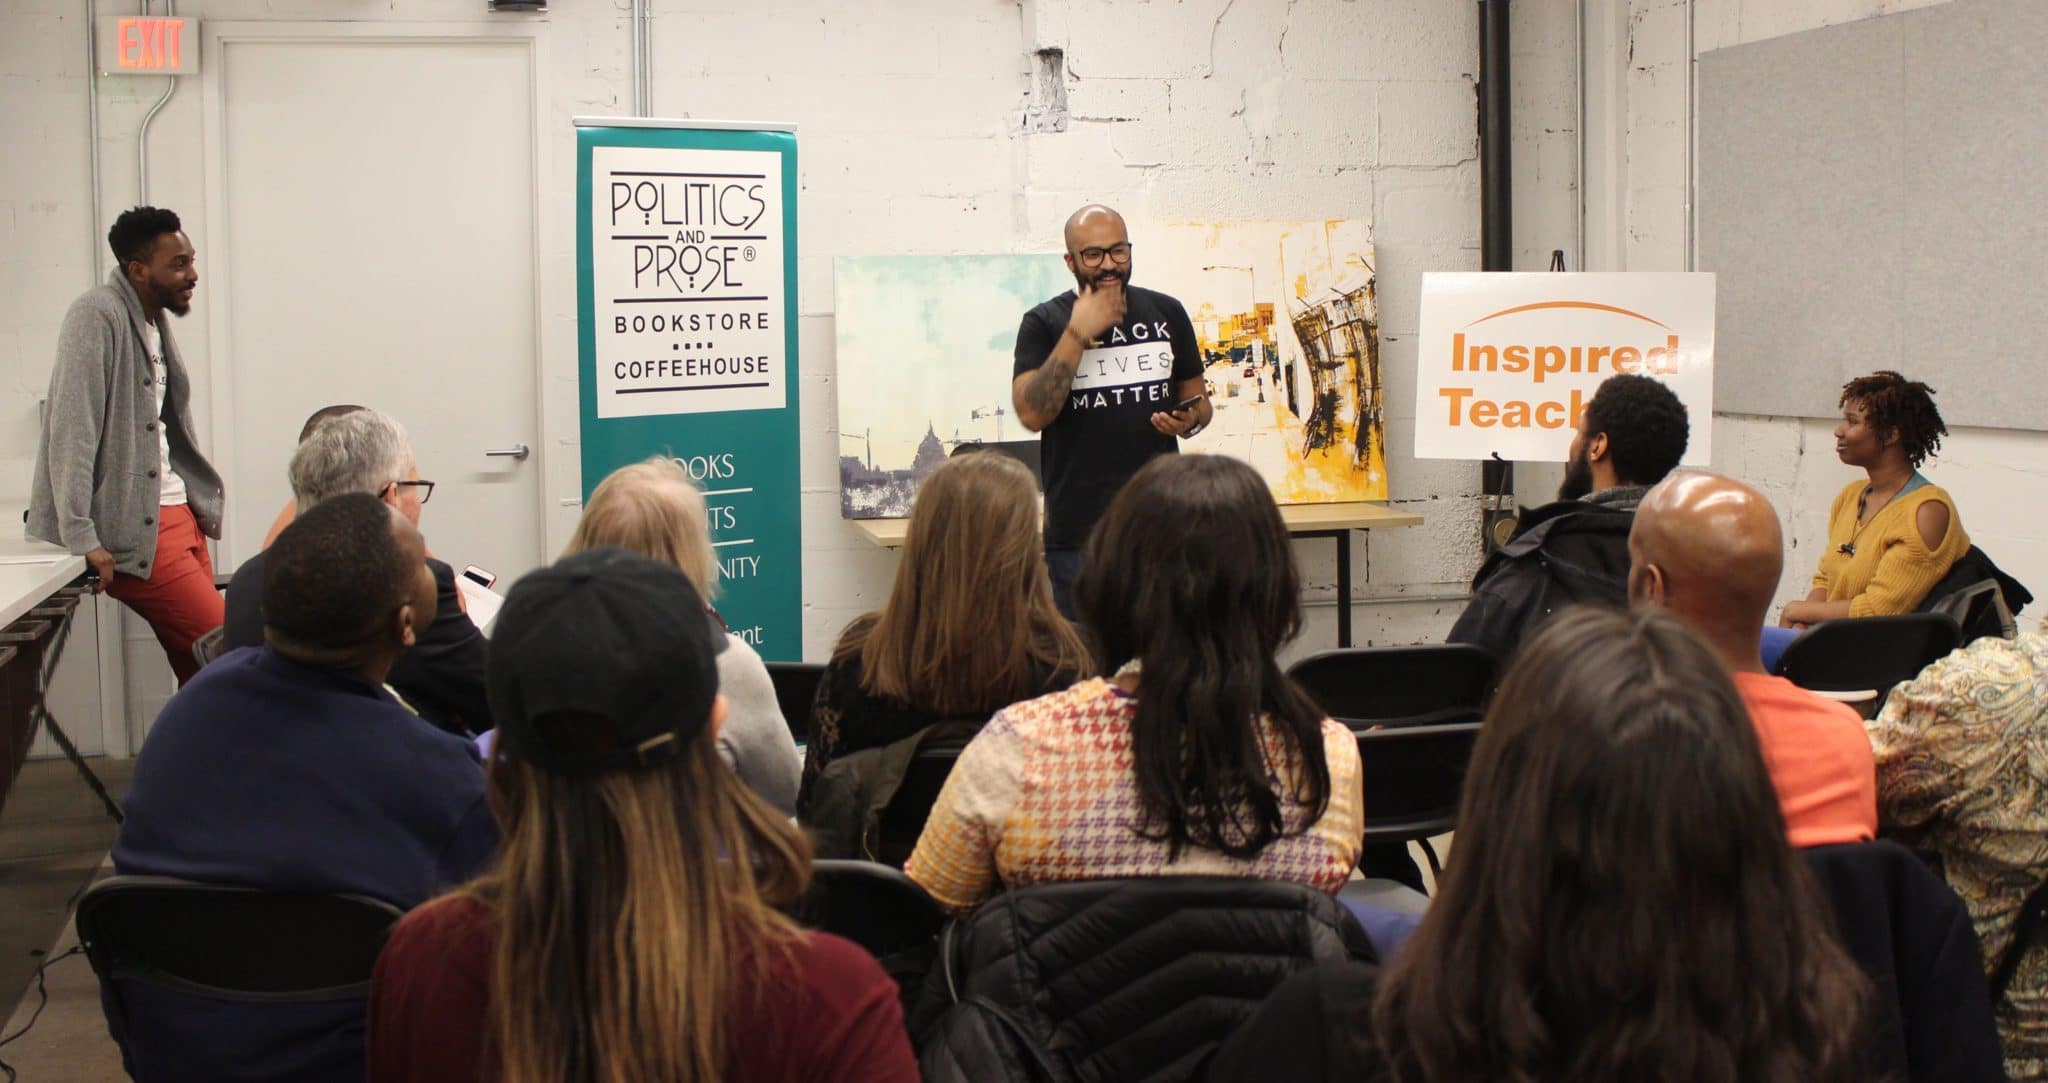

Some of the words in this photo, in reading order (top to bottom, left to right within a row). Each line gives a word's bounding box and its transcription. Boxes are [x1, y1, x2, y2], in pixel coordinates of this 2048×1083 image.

[118, 18, 184, 69] EXIT
[611, 181, 766, 230] POLITICS
[675, 230, 705, 243] AND
[614, 313, 769, 333] BOOKSTORE
[614, 356, 769, 380] COFFEEHOUSE
[1452, 333, 1680, 383] Inspired
[1073, 383, 1169, 409] MATTER
[1439, 387, 1590, 430] Teach
